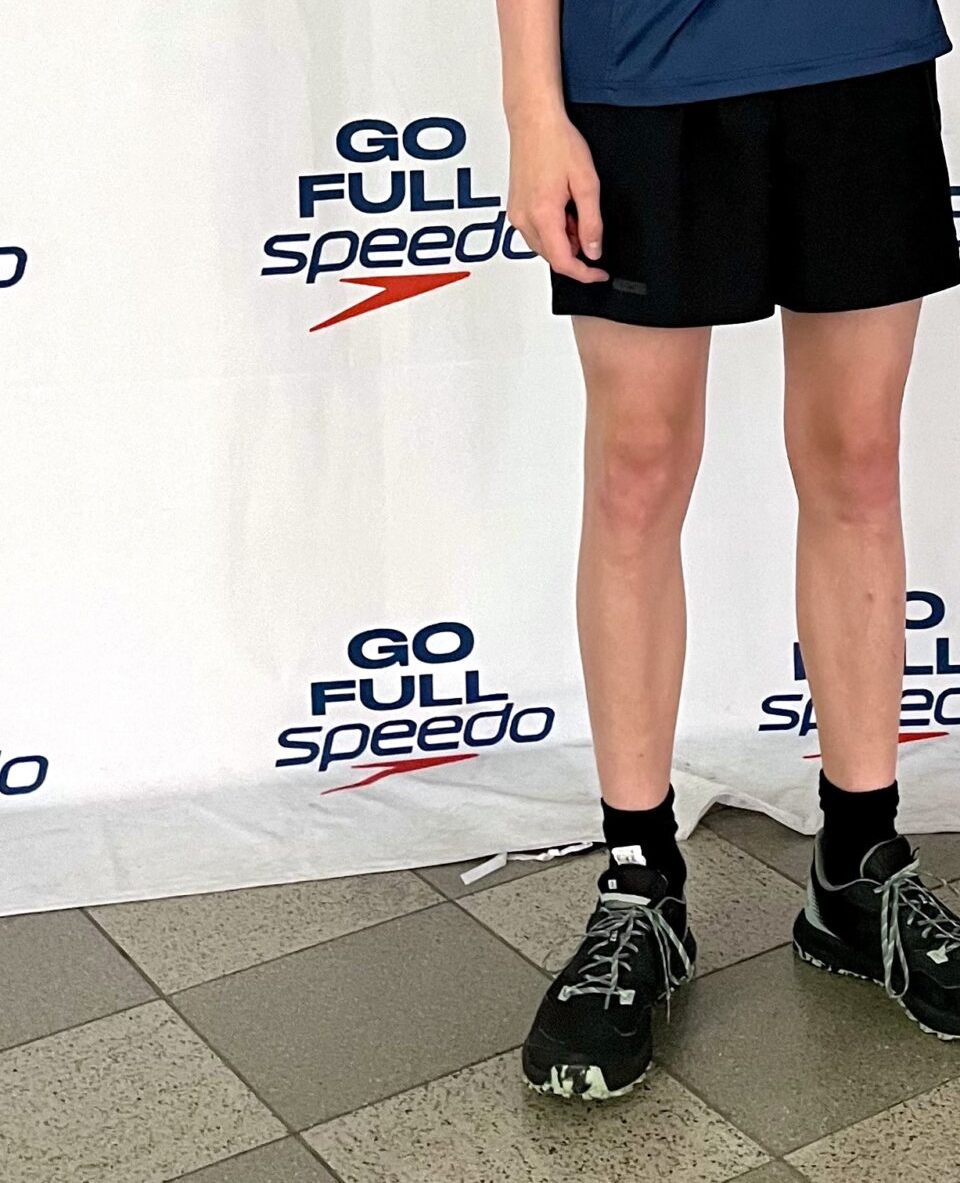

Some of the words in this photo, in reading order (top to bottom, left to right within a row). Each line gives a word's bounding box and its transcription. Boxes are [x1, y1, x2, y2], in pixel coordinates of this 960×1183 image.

[335, 116, 467, 163] GO
[298, 167, 501, 219] FULL
[347, 621, 475, 670] GO
[310, 669, 509, 716] FULL
[275, 702, 556, 772] speedo
